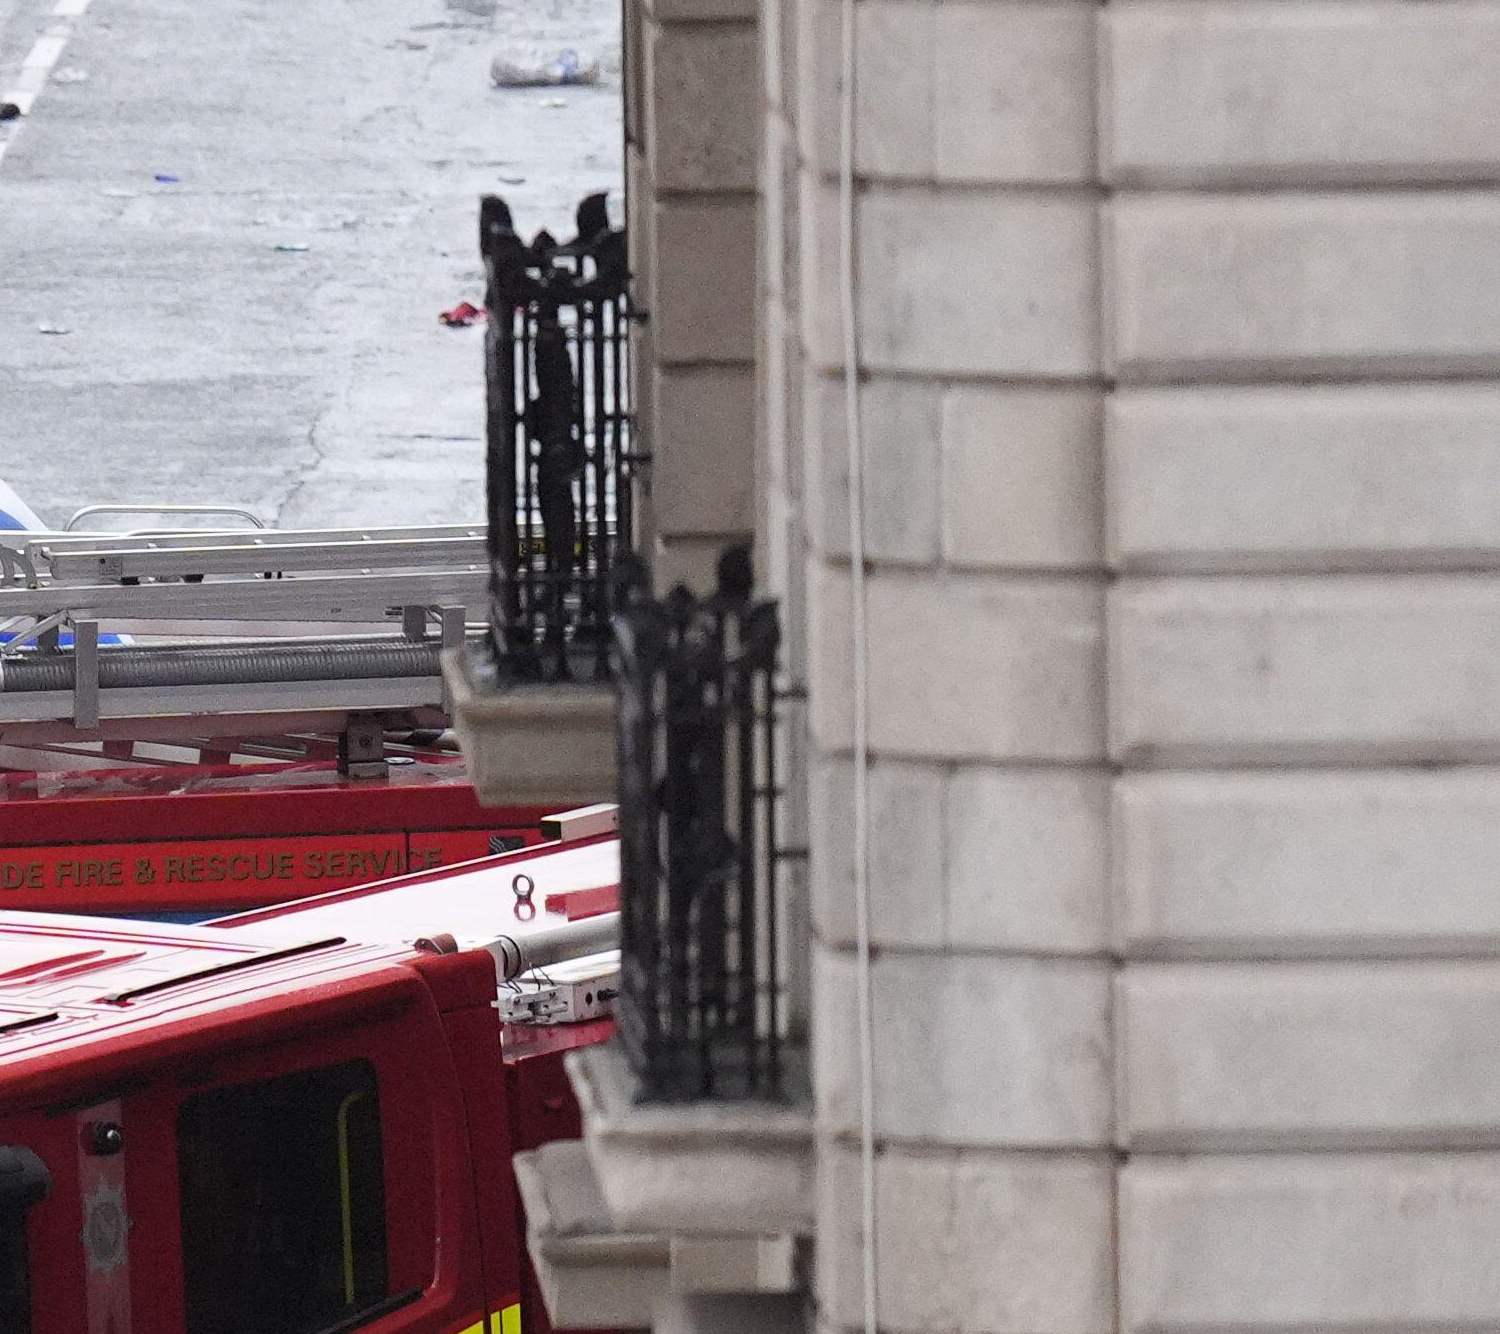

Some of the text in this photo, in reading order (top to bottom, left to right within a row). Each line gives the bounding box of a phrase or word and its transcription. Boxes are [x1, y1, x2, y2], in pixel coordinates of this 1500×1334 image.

[54, 858, 124, 888] FIRE
[134, 857, 158, 885] &
[165, 851, 296, 884] RESCUE
[304, 846, 443, 878] SERVICE
